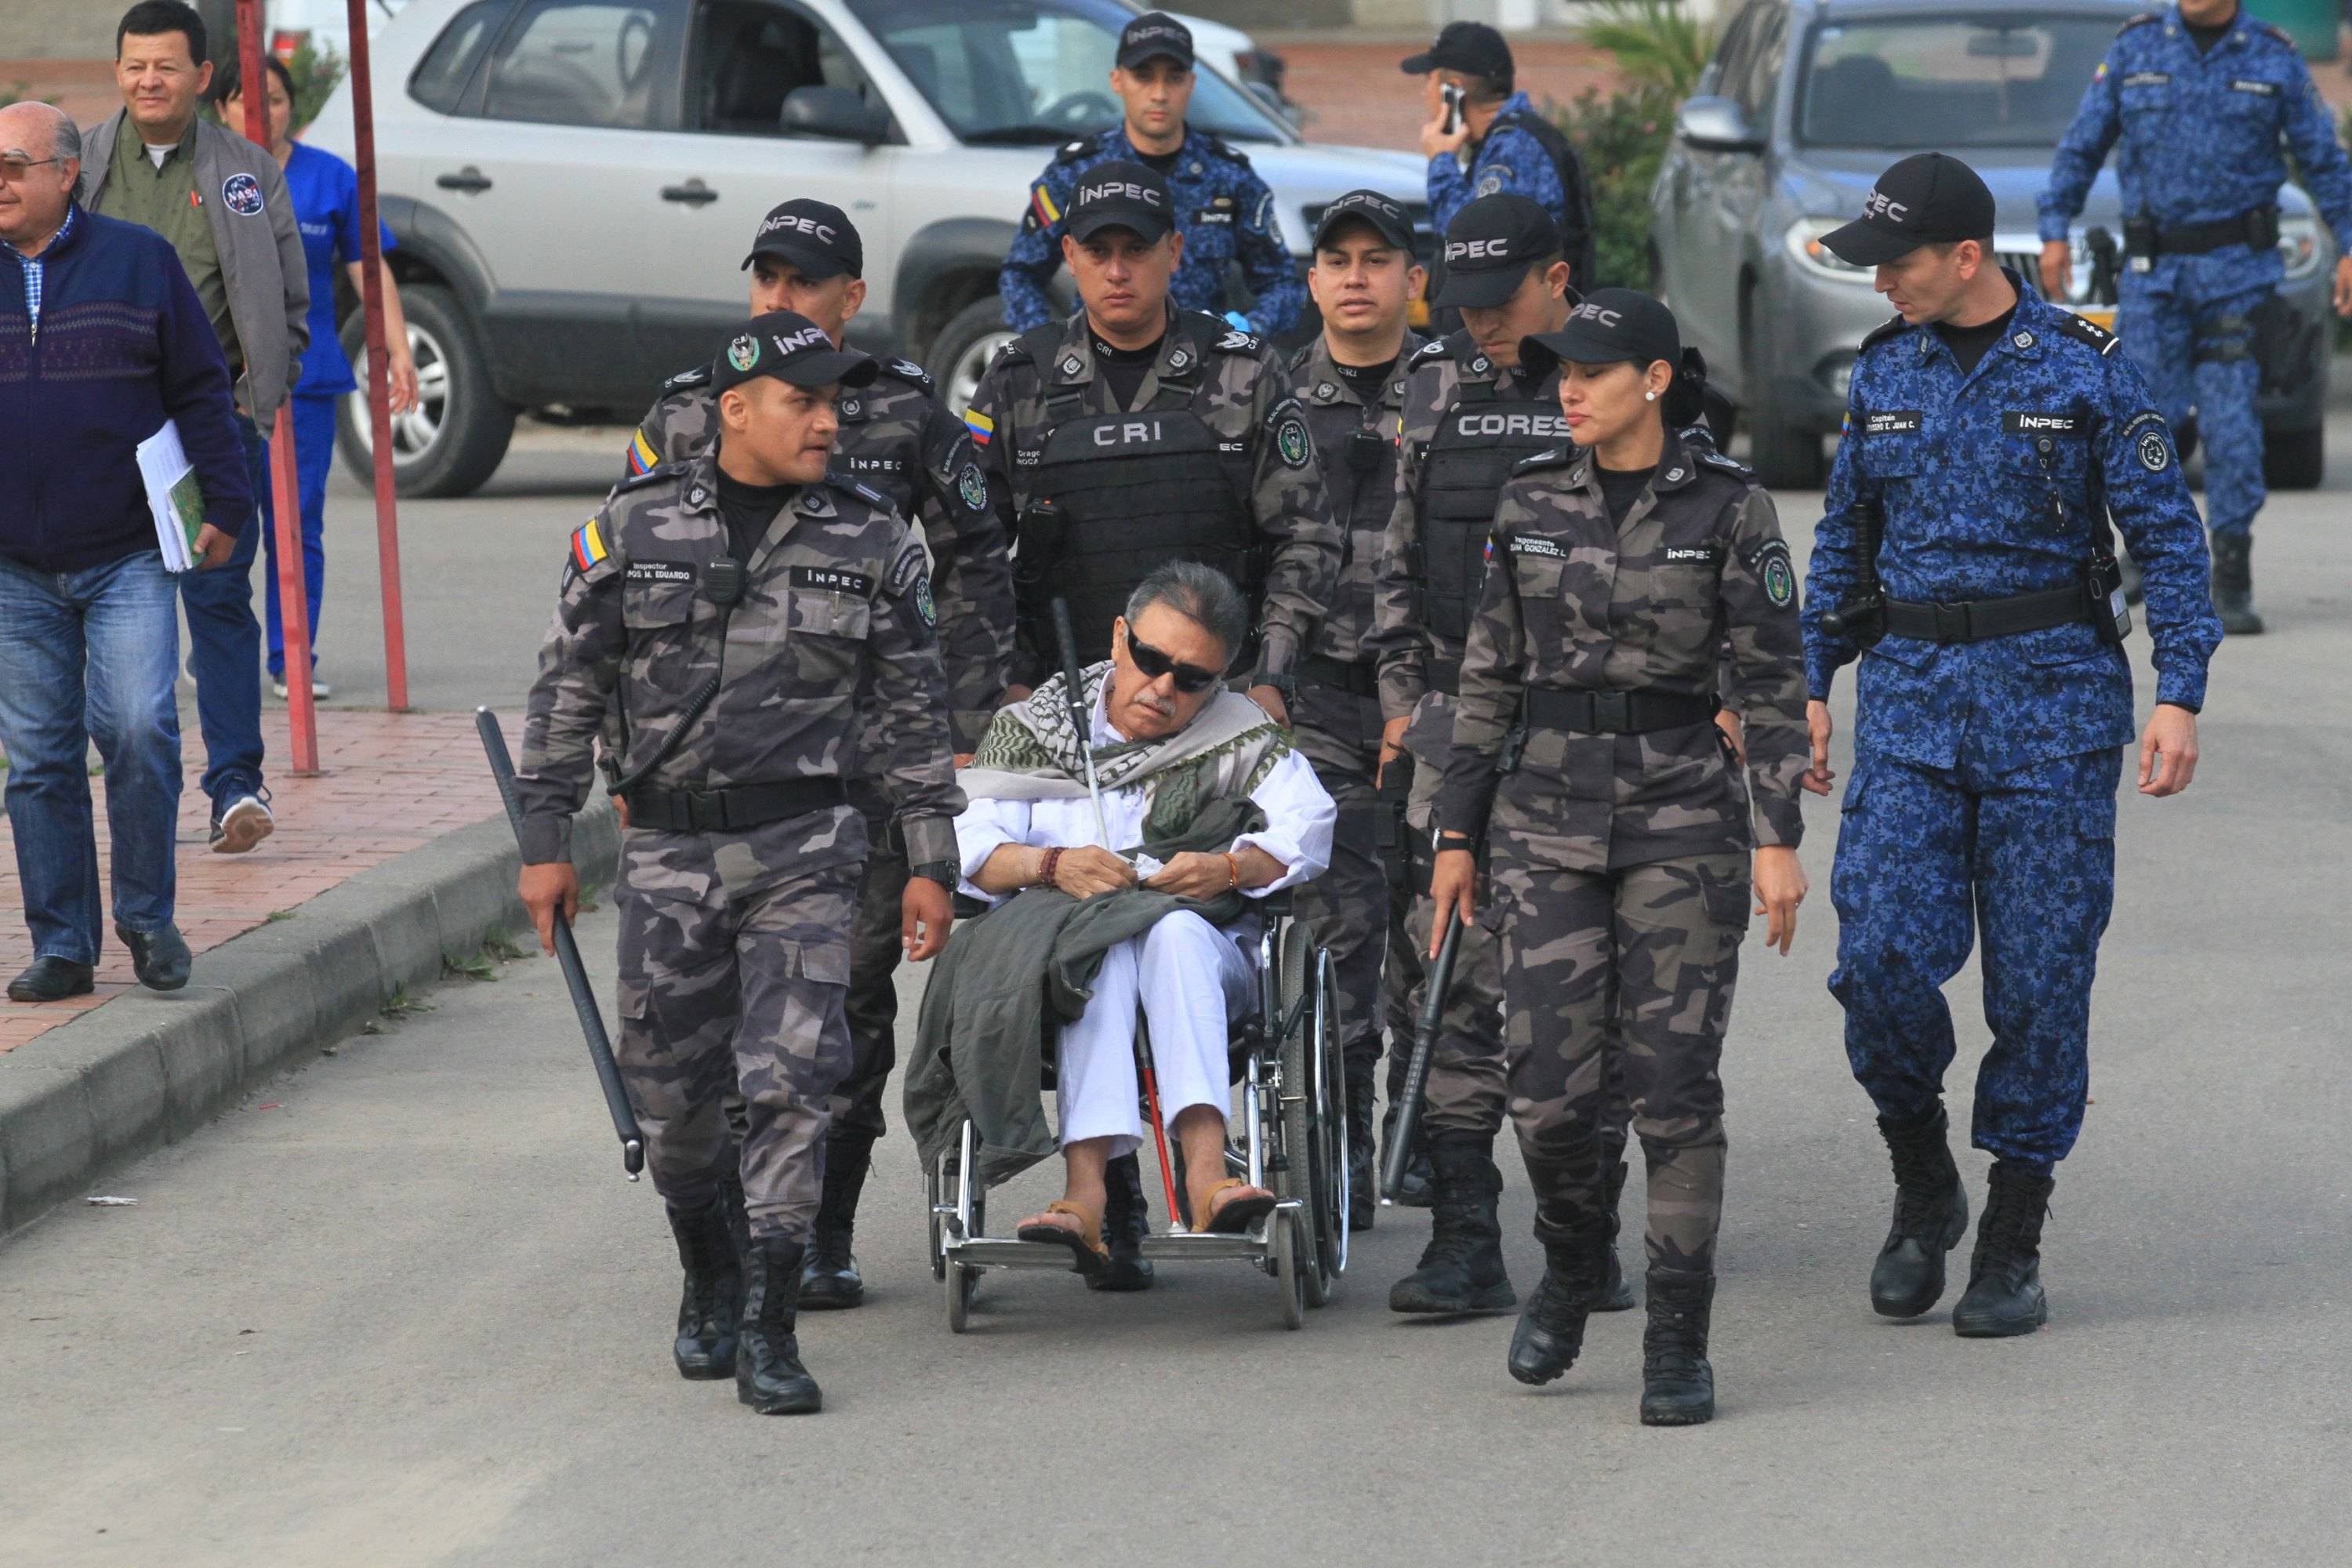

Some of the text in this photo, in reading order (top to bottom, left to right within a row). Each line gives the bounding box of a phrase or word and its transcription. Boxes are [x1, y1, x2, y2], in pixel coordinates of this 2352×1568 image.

[227, 188, 260, 203] NASA
[1097, 342, 1112, 357] CRI
[1094, 421, 1161, 446] CRI
[655, 571, 690, 580] EDUARDO
